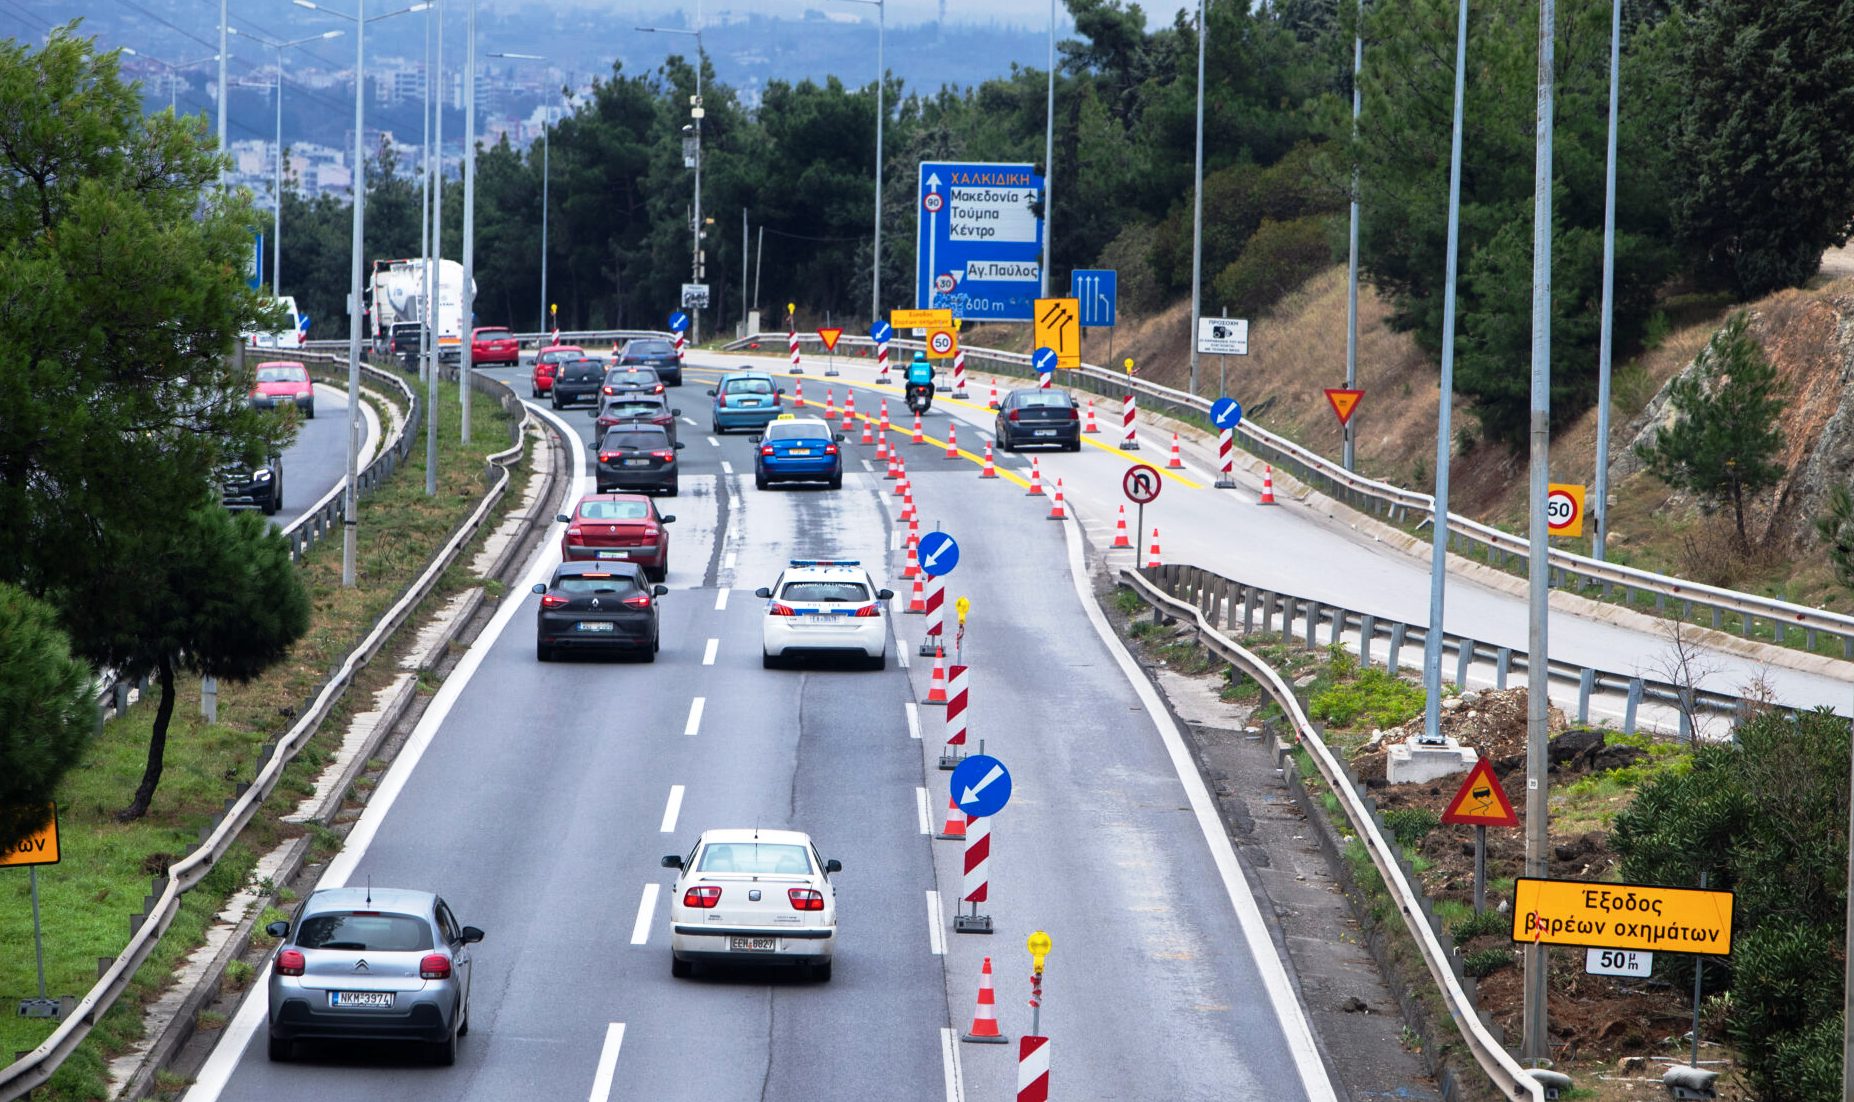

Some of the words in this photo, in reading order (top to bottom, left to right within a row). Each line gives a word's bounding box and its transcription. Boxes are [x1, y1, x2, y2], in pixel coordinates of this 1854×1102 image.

[951, 172, 1030, 185] ΧΑΛΚΙΔΙΚΗ
[927, 198, 939, 206] 90
[951, 190, 1018, 203] Μακεδονία
[952, 206, 999, 221] Τούμπα
[950, 223, 995, 239] Κέντρο
[940, 279, 951, 288] 30
[966, 298, 989, 311] 600
[992, 302, 1005, 312] m
[935, 338, 949, 348] 50
[1548, 502, 1570, 518] 50
[1582, 889, 1663, 916] Έξοδος
[1614, 921, 1720, 943] οχημάτων
[1600, 952, 1626, 969] 50
